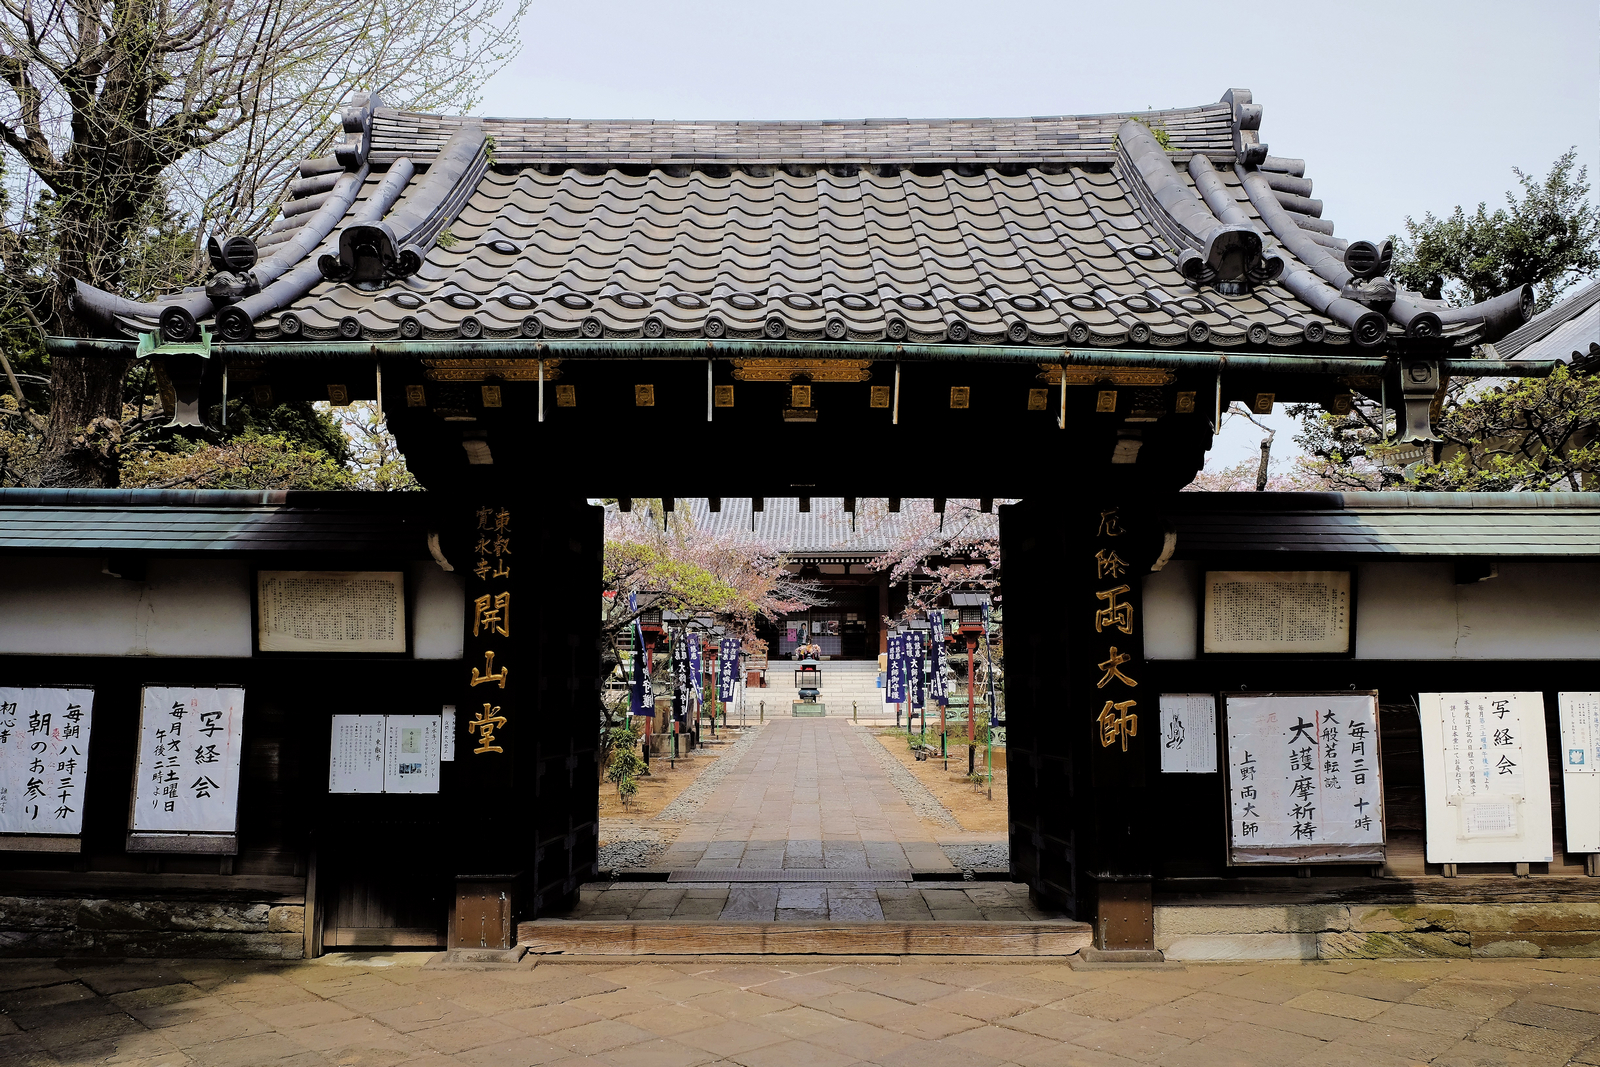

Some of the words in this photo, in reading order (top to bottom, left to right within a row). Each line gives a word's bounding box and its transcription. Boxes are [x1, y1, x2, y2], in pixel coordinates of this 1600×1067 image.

[473, 506, 493, 581] 寛永寺
[492, 507, 512, 579] 東叡山
[1095, 507, 1138, 752] 厄除両大師
[468, 591, 510, 754] 開山堂
[23, 709, 52, 820] 朝のお参り
[54, 703, 84, 819] 毎朝八時三十分
[152, 729, 167, 809] 午後二時より
[190, 710, 224, 799] 写経会
[1319, 709, 1342, 790] 大般若転読
[1347, 720, 1370, 785] 毎月三日
[1491, 699, 1517, 776] 写経会
[1240, 750, 1260, 838] 上野両大師
[1353, 797, 1373, 832] 十時
